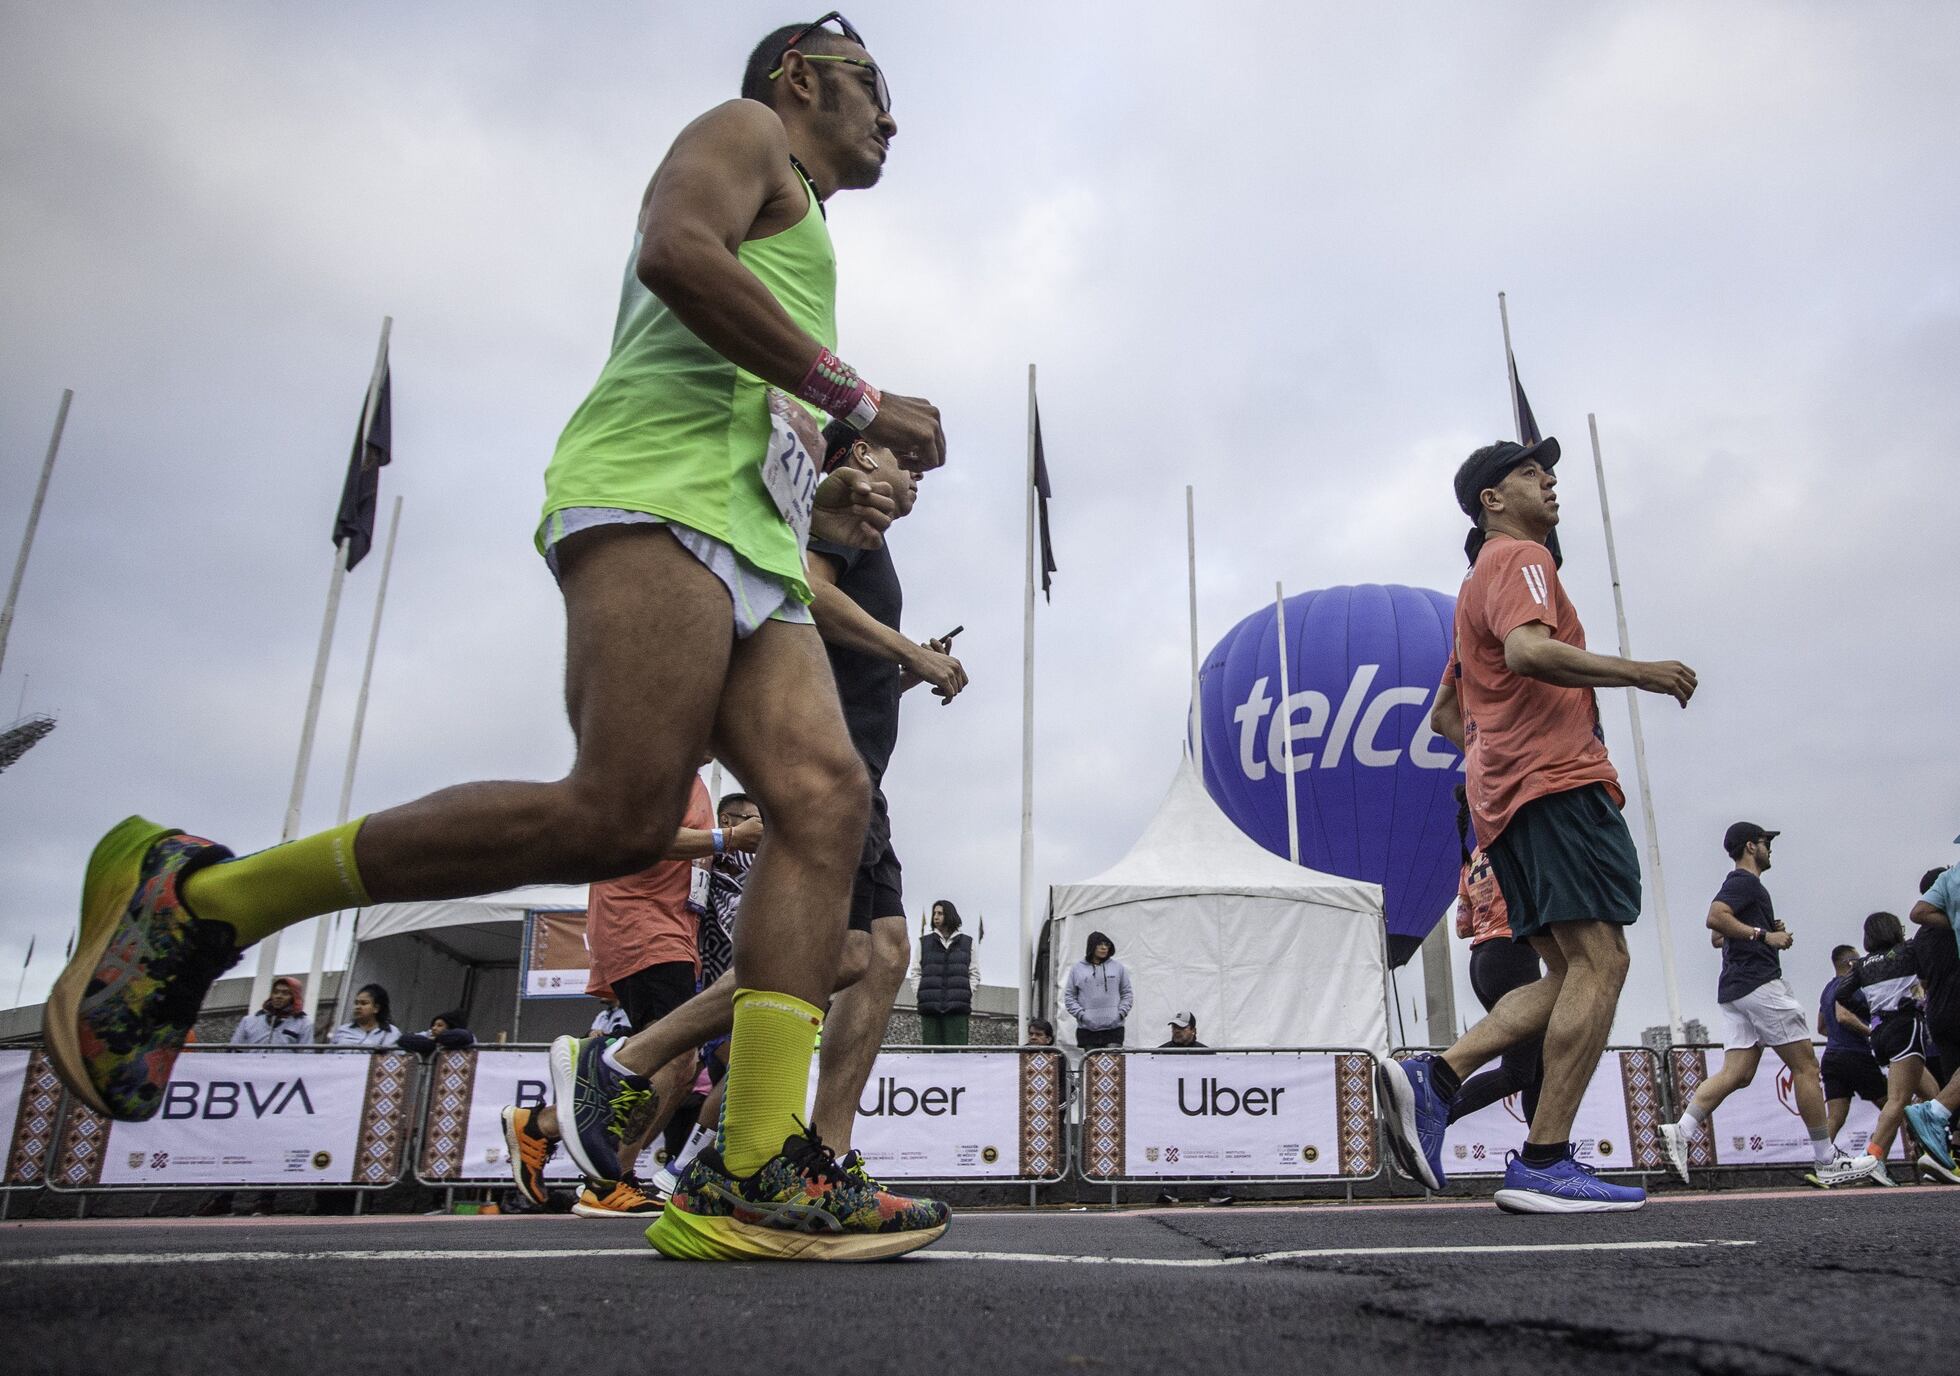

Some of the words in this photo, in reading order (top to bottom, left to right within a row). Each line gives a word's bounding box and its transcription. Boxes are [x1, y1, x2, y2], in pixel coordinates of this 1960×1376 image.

[1233, 664, 1466, 781] telce
[162, 1077, 315, 1120] BBVA
[857, 1077, 966, 1117] Uber
[1178, 1077, 1285, 1116] Uber
